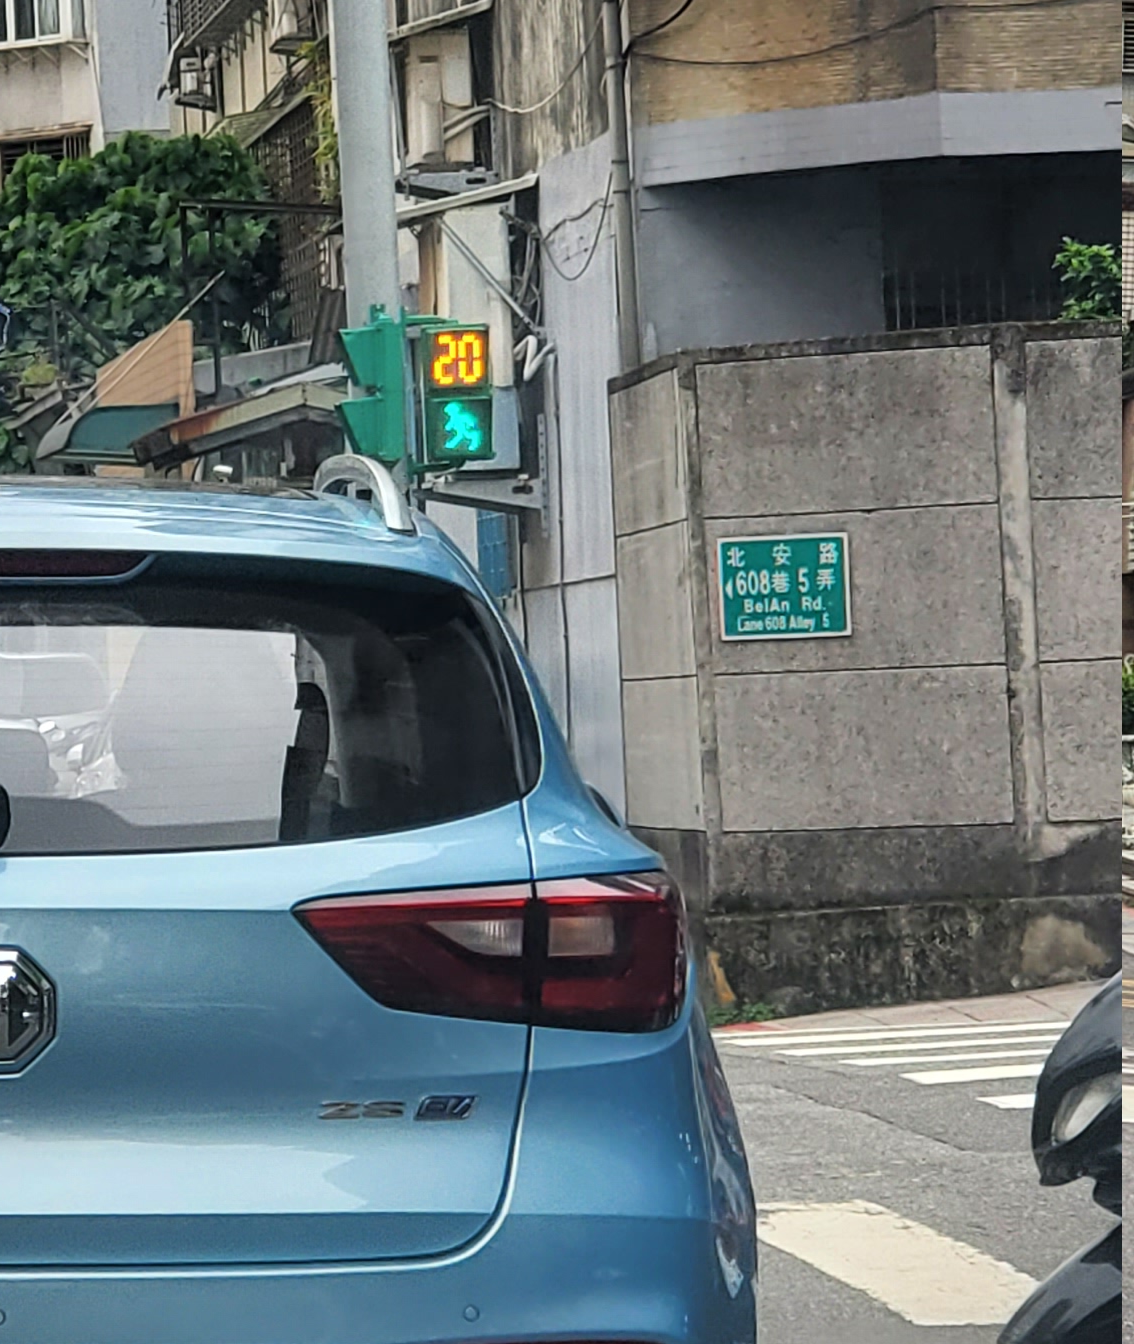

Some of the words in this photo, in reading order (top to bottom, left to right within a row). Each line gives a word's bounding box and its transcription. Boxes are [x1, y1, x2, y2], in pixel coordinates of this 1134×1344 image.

[433, 333, 482, 385] 20
[726, 542, 839, 568] 北安路
[743, 597, 791, 614] BeiAn
[801, 596, 827, 612] Rd.
[737, 616, 764, 632] Lane
[765, 615, 786, 631] 608
[789, 614, 815, 632] Alley
[822, 612, 831, 628] 5
[318, 1100, 406, 1120] ZS
